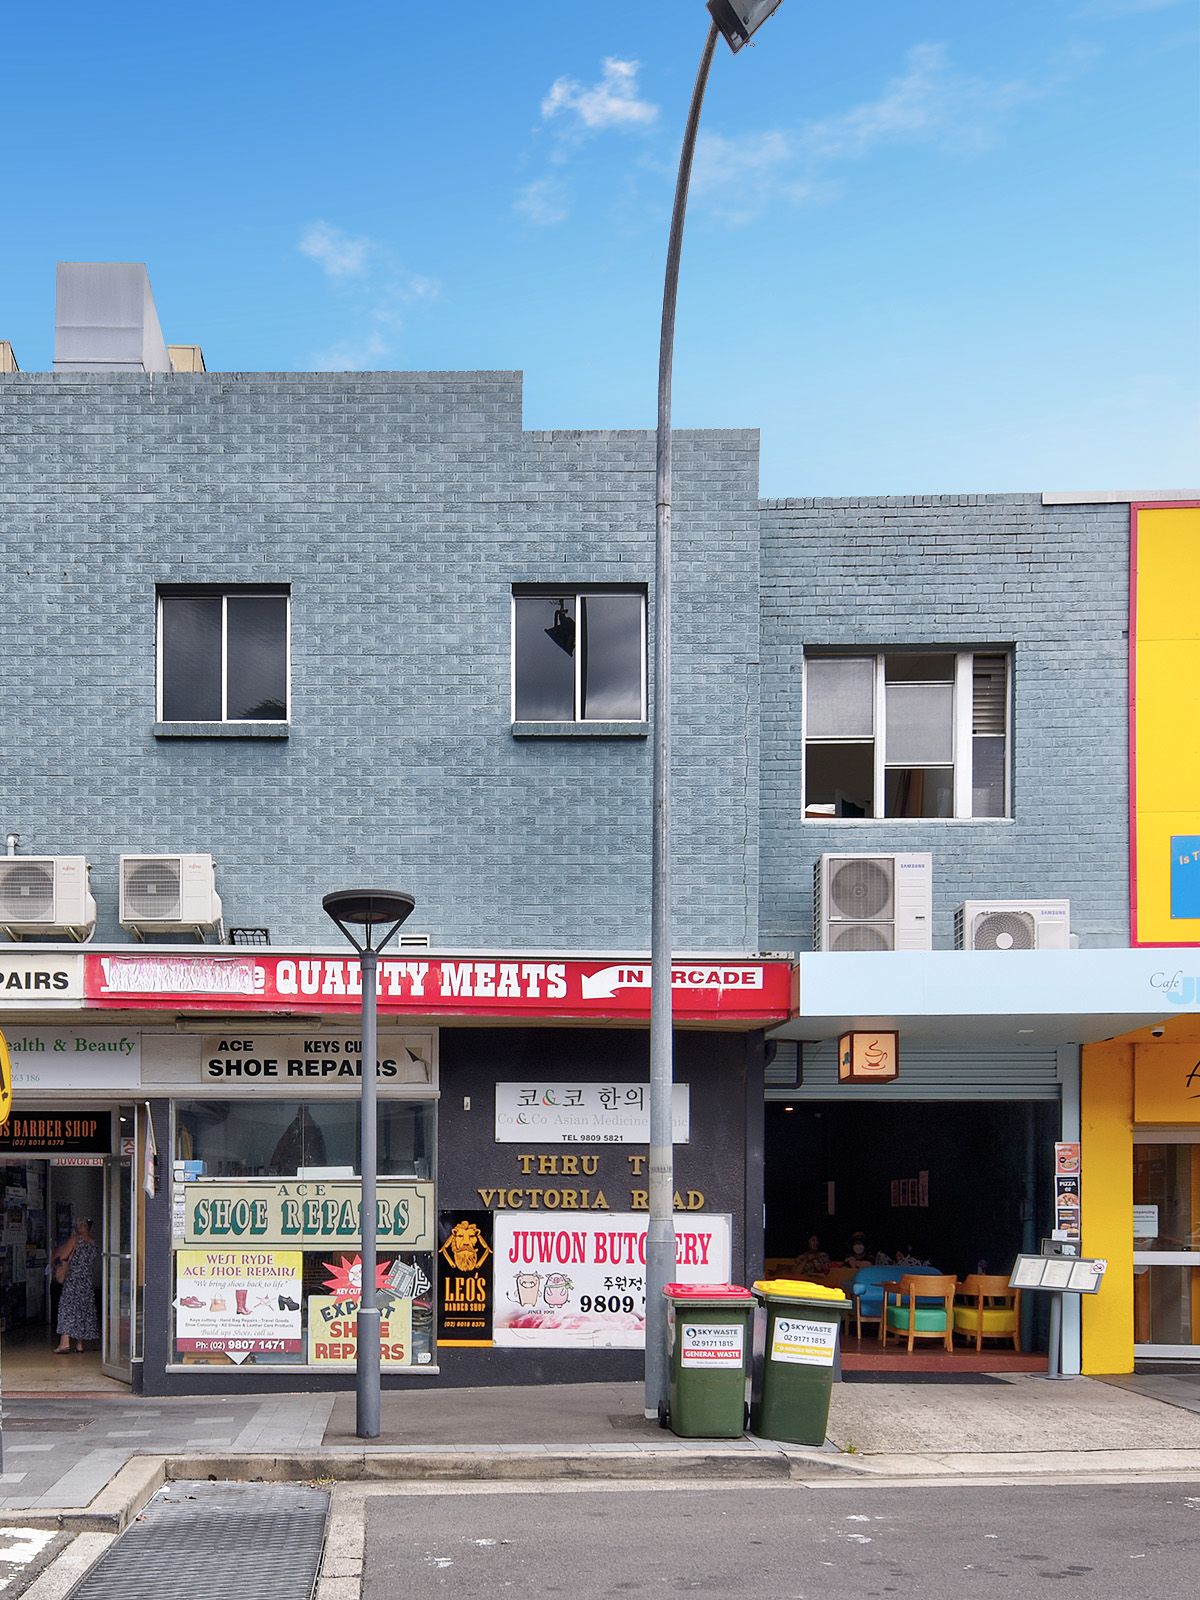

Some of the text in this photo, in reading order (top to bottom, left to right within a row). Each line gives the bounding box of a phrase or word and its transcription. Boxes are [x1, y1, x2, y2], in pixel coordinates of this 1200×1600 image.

[1179, 855, 1190, 865] Is
[440, 963, 568, 999] MEATS
[617, 970, 757, 984] IN RCADE
[1150, 970, 1183, 993] Cafe
[7, 1037, 45, 1051] ealth
[53, 1038, 67, 1052] &
[75, 1037, 136, 1055] Beauty
[217, 1040, 362, 1053] ACE KEYS CU
[208, 1059, 278, 1077] SHOE
[26, 1074, 41, 1082] 186
[597, 1086, 645, 1111] 한의
[497, 1112, 648, 1126] Co & Co Asian Medicine
[13, 1119, 62, 1137] BARBER
[65, 1119, 97, 1137] SHOP
[12, 1139, 26, 1147] (02)
[56, 1158, 91, 1166] JUWON
[517, 1154, 647, 1175] THRU T
[278, 1184, 327, 1196] ACE
[478, 1188, 705, 1210] VICTORIA RAD
[193, 1198, 269, 1236] SHOE
[280, 1199, 410, 1236] REPARS
[509, 1230, 713, 1265] JUWON BUTCERY
[207, 1254, 274, 1265] WEST RYDE
[183, 1266, 296, 1277] ACE SHOE REPAIRS
[208, 1280, 226, 1289] bring
[227, 1280, 245, 1288] shoes
[246, 1280, 262, 1288] back
[444, 1272, 487, 1302] LEO'S
[603, 1276, 643, 1292] 주원정
[320, 1300, 396, 1323] EXPT
[444, 1303, 486, 1312] BARBER SHOP
[580, 1294, 635, 1314] 9809
[330, 1321, 390, 1338] SHE
[195, 1340, 285, 1350] Ph: (02) 9807 1471
[793, 1335, 810, 1343] 9171
[811, 1337, 827, 1345] 1815
[315, 1342, 405, 1360] REPRS
